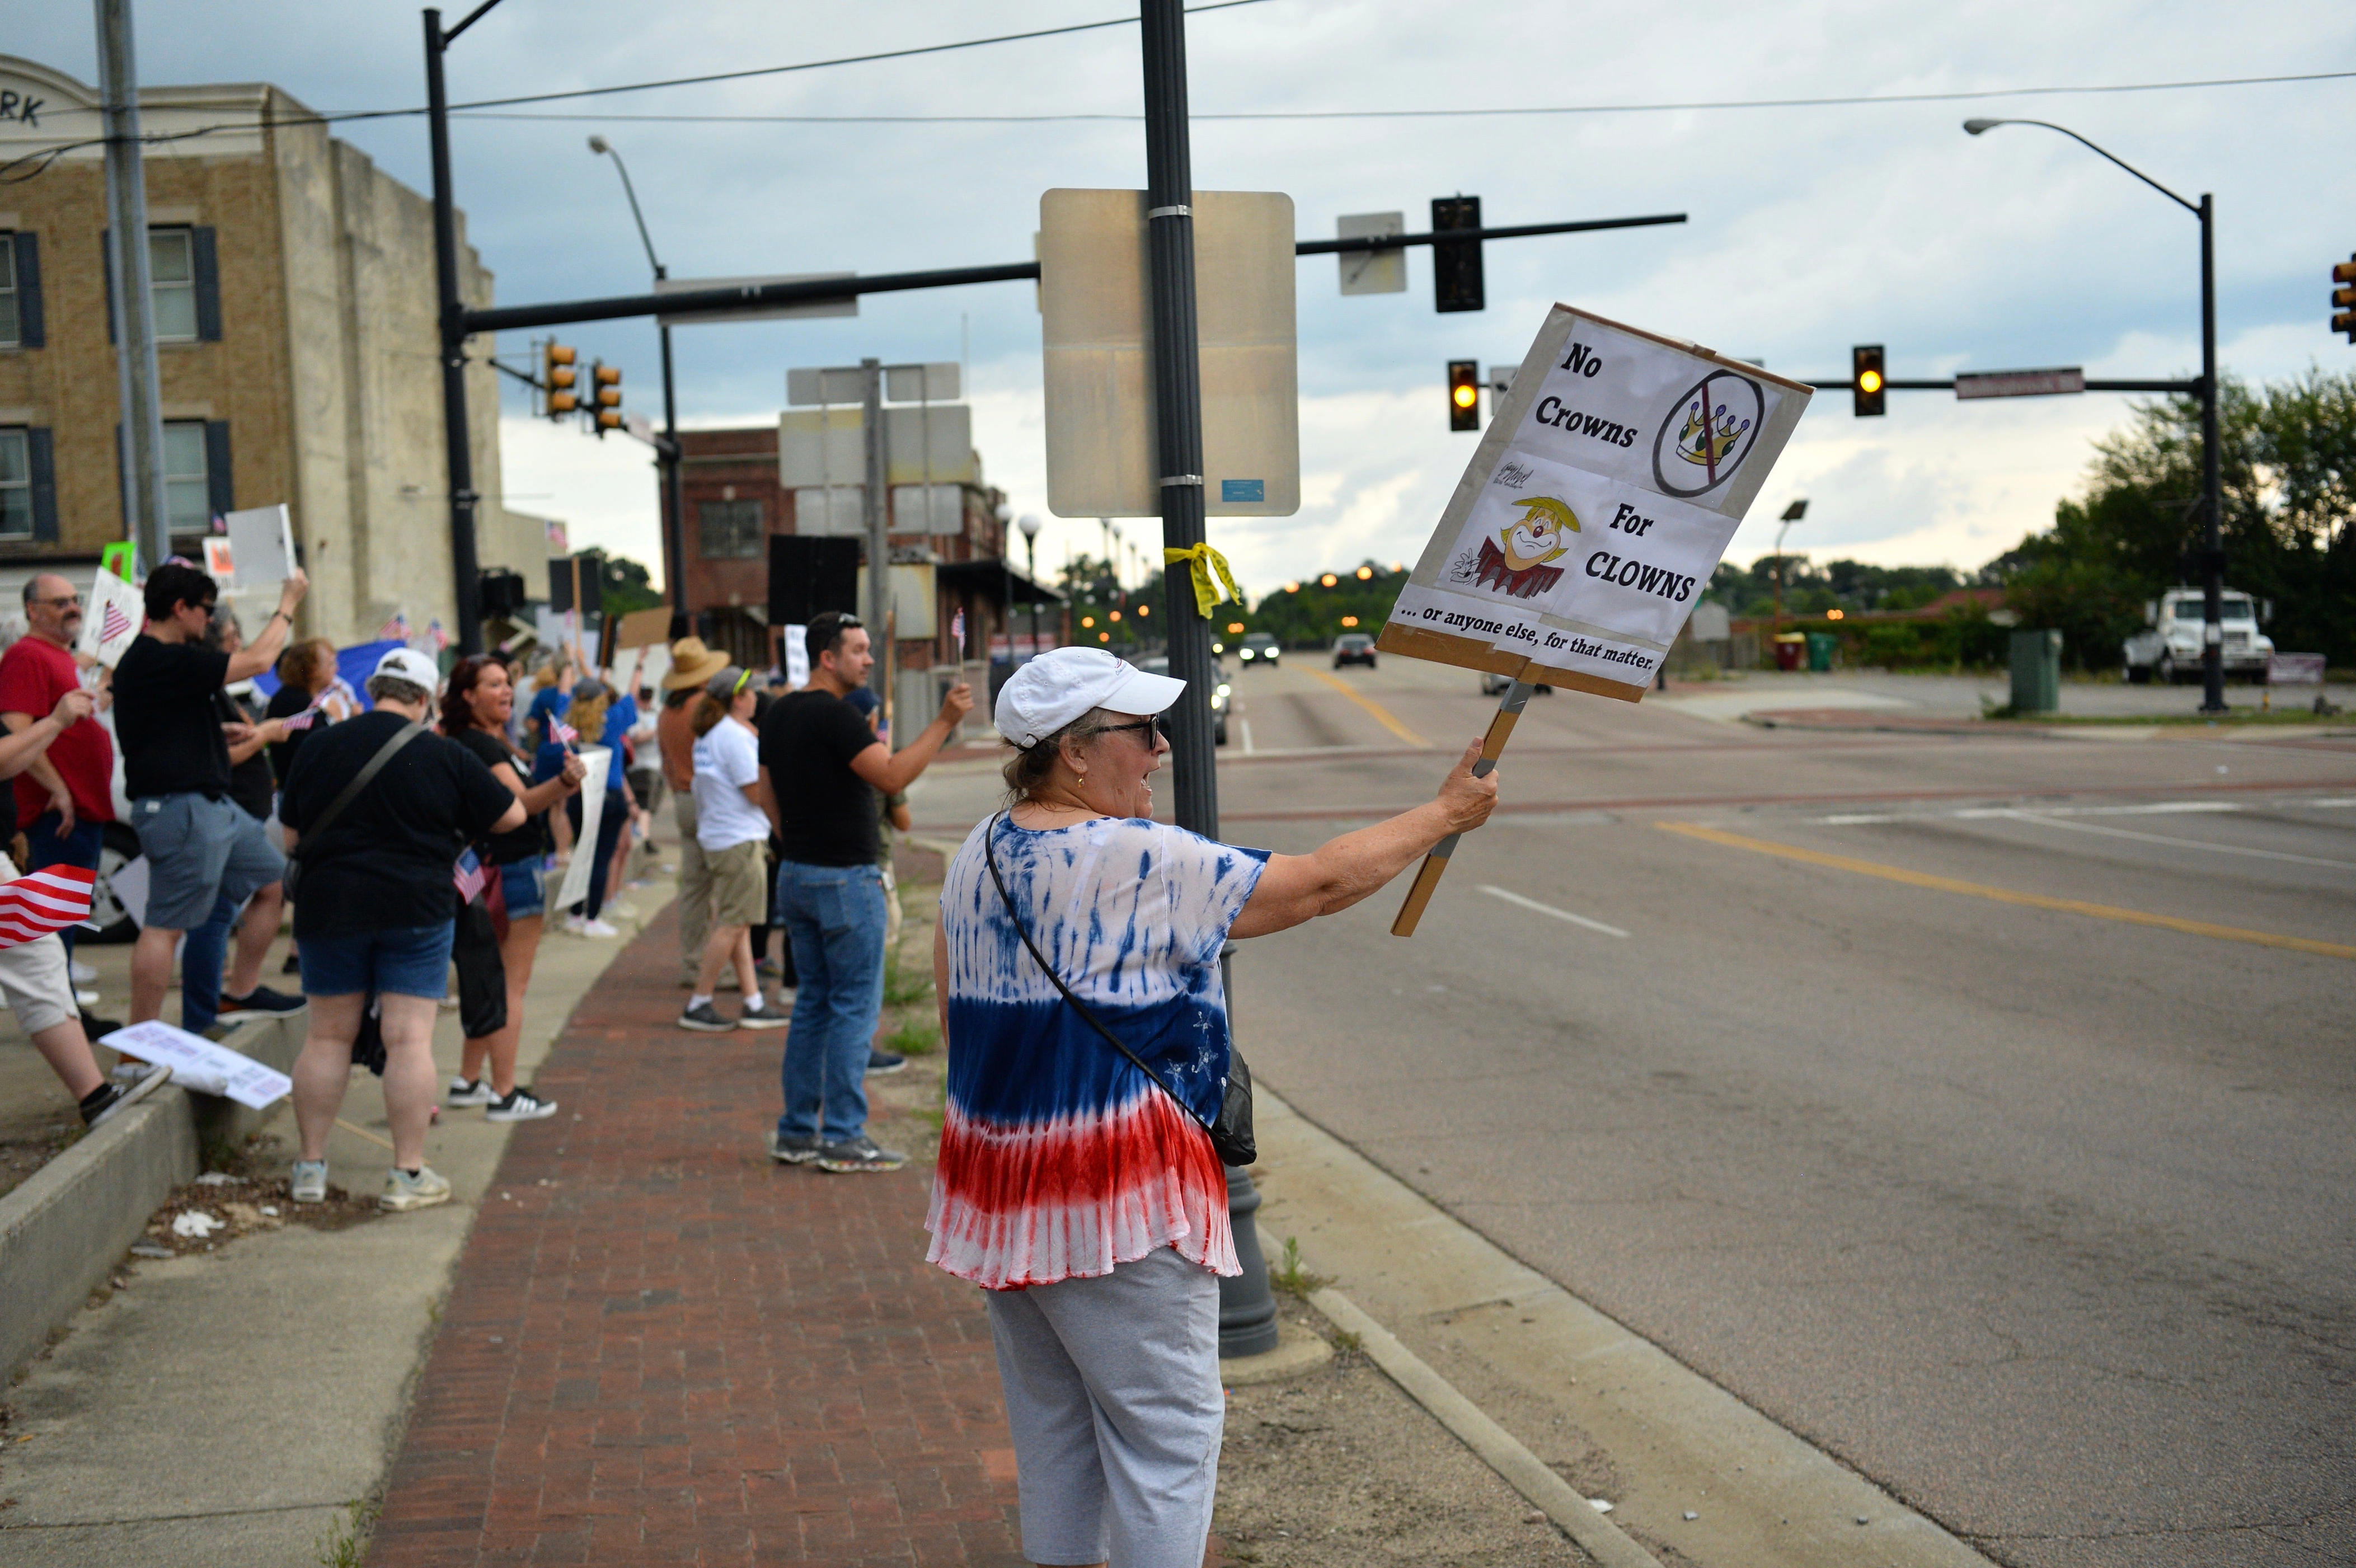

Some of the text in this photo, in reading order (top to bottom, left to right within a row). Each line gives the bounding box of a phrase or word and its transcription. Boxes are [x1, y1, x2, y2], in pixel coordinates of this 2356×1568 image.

[1560, 342, 1602, 378] No
[1536, 396, 1638, 448] Crowns
[1609, 503, 1654, 537] For
[1585, 551, 1696, 603] CLOWNS
[1423, 607, 1443, 621] or
[1444, 612, 1503, 634] anyone
[1505, 623, 1539, 647] else,
[1543, 632, 1569, 650] for
[1570, 638, 1603, 658] that
[1602, 649, 1654, 670] matter.
